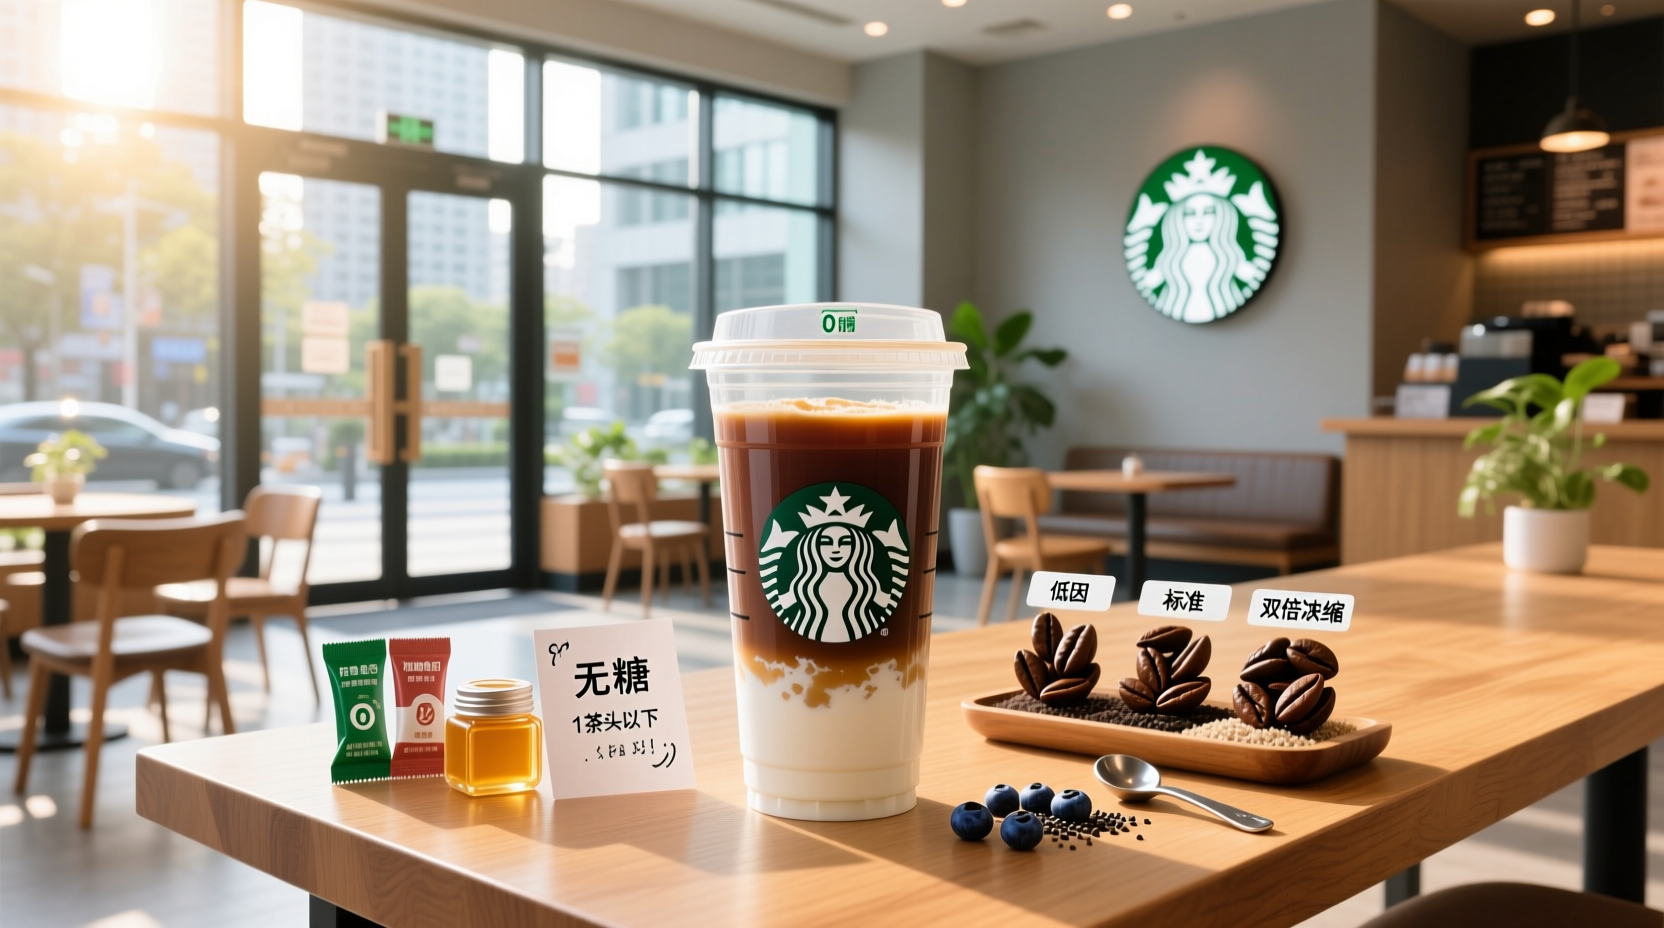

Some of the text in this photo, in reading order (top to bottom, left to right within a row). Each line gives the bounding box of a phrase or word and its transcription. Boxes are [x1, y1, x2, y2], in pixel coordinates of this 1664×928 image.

[1051, 581, 1088, 603] 低因
[1163, 589, 1204, 611] 标准
[575, 656, 650, 698] 无糖
